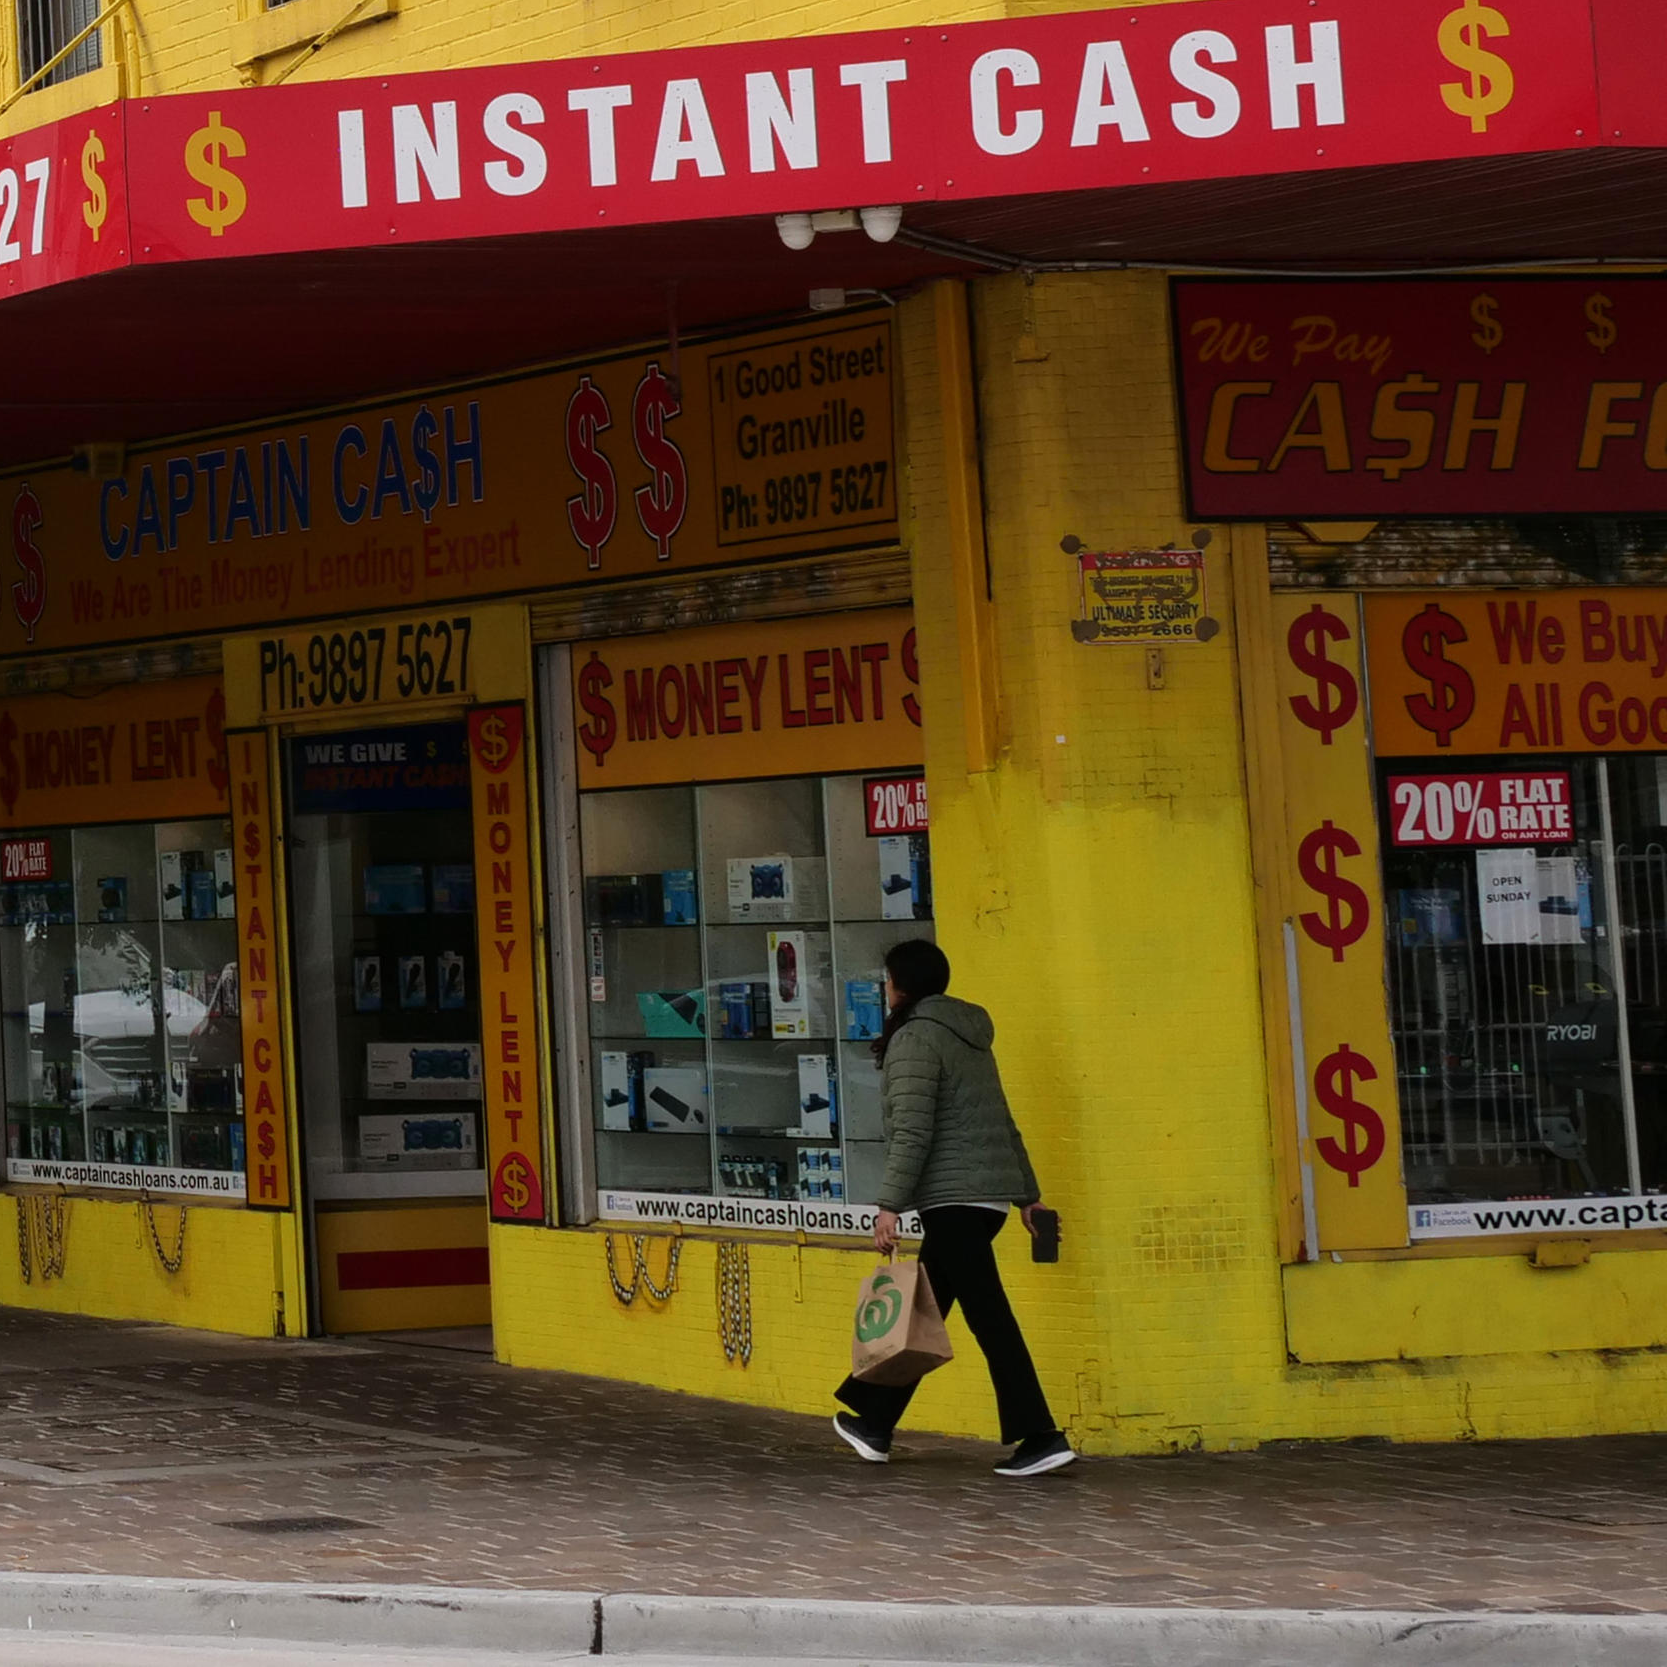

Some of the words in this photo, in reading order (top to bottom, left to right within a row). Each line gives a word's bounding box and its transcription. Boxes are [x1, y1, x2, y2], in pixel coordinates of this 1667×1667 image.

[337, 59, 908, 210] INSTANT
[968, 19, 1347, 157] CASH
[715, 367, 727, 403] 1
[735, 351, 803, 400] Good
[809, 336, 886, 387] Street
[1190, 318, 1269, 363] We
[1289, 315, 1394, 376] Pay
[736, 399, 867, 462] Granville
[1202, 373, 1528, 482] CA$H
[1577, 380, 1667, 472] F
[99, 435, 311, 562] CAPTAIN
[332, 400, 485, 525] CA$H
[721, 485, 759, 532] Ph:
[766, 472, 822, 524] 9897
[830, 460, 888, 515] 5627
[70, 578, 105, 625] We
[111, 574, 152, 620] Are
[160, 563, 203, 612] The
[211, 555, 294, 613] Money
[303, 538, 415, 597] Lending
[423, 521, 522, 579] Expert
[395, 616, 473, 699] 5627
[1485, 600, 1566, 665] We
[1579, 599, 1667, 678] Buy
[624, 653, 769, 742] MONEY
[779, 641, 890, 729] LENT
[1498, 683, 1564, 748] All
[23, 724, 116, 790] MONEY
[129, 716, 200, 782] LENT
[304, 743, 346, 764] WE
[350, 742, 408, 763] GIVE
[872, 782, 916, 829] 20%
[1395, 780, 1497, 842] 20%
[1499, 778, 1565, 805] FLAT
[1499, 804, 1571, 831] RATE
[4, 842, 28, 879] 20%
[28, 841, 46, 857] FLAT
[28, 856, 48, 872] RATE
[1500, 831, 1517, 840] ON
[1519, 831, 1541, 840] ANY
[1543, 830, 1569, 839] LOAN
[486, 782, 517, 973] MONEY
[1486, 891, 1532, 904] SUNDAY
[1492, 876, 1523, 887] OPEN
[1546, 1023, 1598, 1042] RYOBI
[498, 990, 524, 1144] LENT
[31, 1163, 230, 1191] www.captaincashloans.com.au
